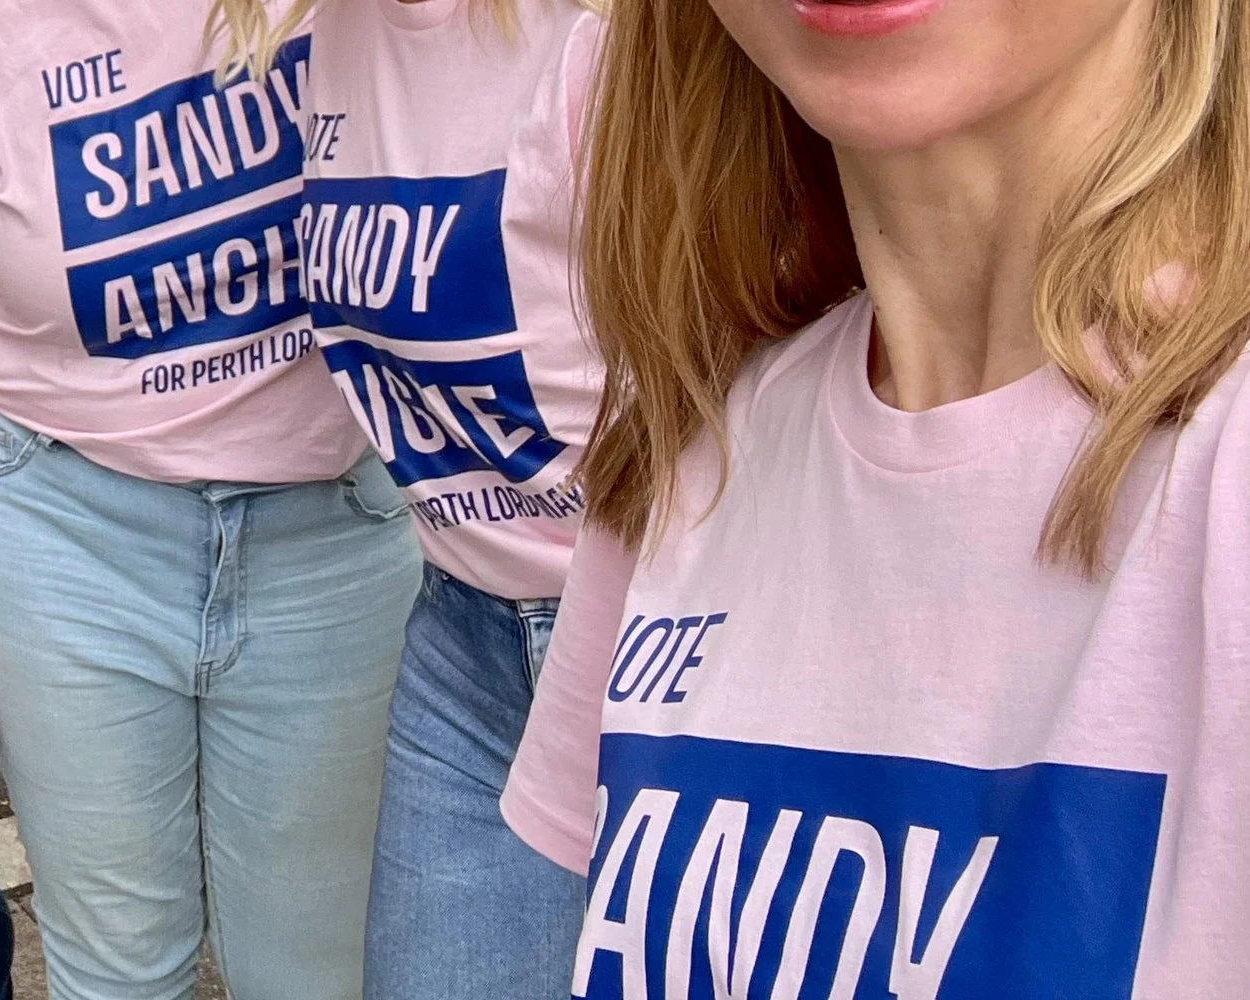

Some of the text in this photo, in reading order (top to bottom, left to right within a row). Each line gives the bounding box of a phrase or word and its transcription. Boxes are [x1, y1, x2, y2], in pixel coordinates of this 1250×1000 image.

[42, 50, 126, 109] VOTE
[304, 112, 346, 162] OTE
[141, 329, 317, 394] FOR PERTH LOR
[570, 785, 999, 1000] ANDY
